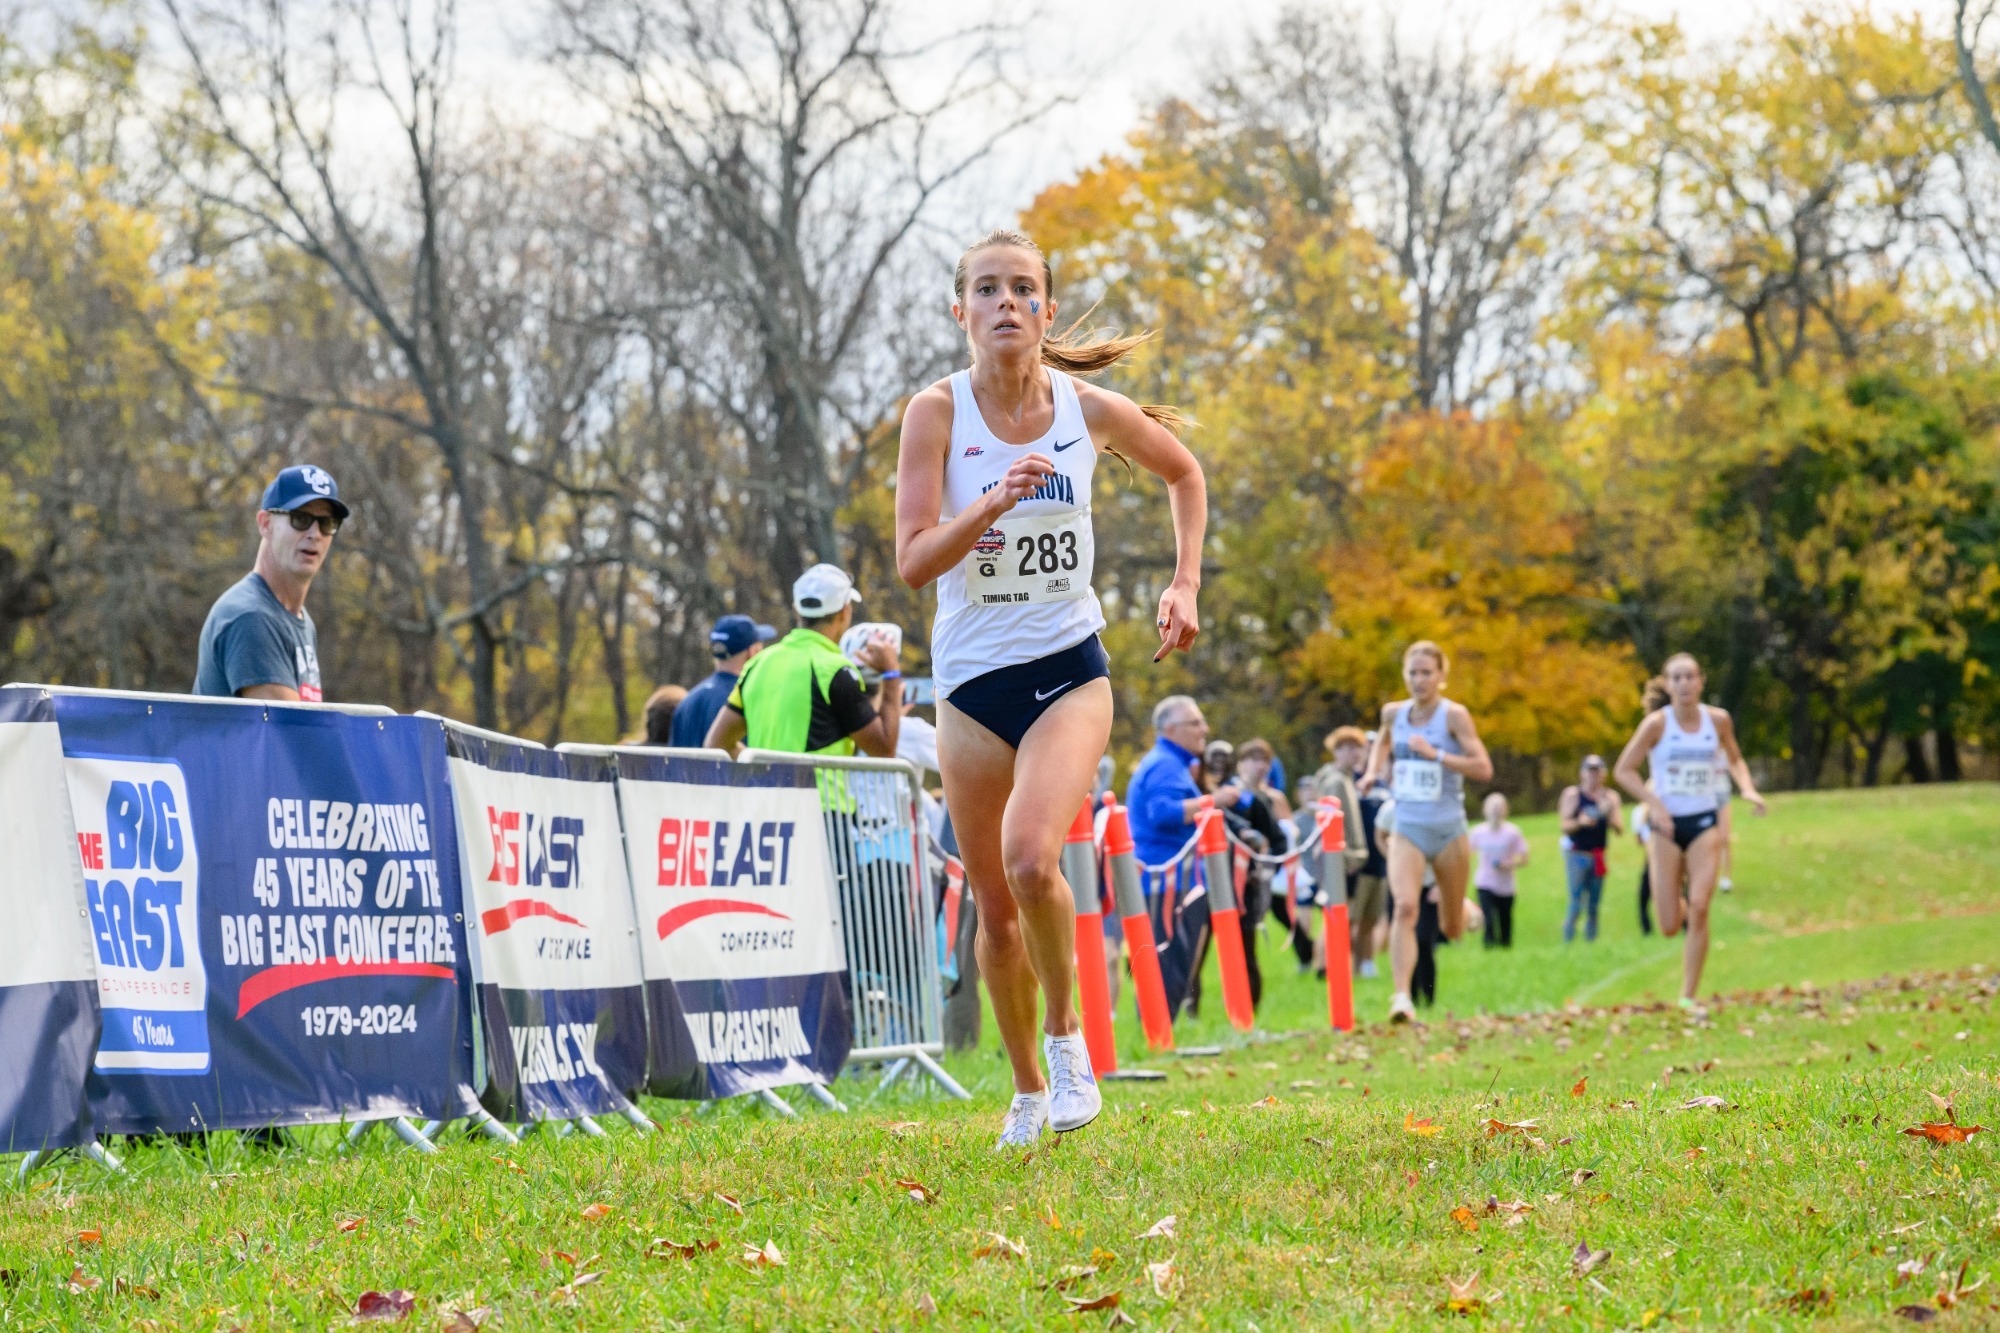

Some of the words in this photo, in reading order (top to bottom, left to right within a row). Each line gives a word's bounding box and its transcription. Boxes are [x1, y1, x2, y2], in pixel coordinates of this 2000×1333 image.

[979, 562, 996, 578] G
[1017, 530, 1079, 577] 283
[982, 594, 1012, 603] TIMING
[1013, 592, 1030, 602] TAG
[1413, 769, 1438, 788] 185
[106, 780, 184, 872] BIG
[267, 797, 430, 852] CELEBRATING
[657, 818, 710, 887] BIG
[710, 821, 796, 887] EAST
[253, 857, 280, 908] 45
[284, 856, 368, 909] YEARS
[375, 859, 414, 909] OF
[85, 876, 185, 972] EAST
[220, 914, 264, 965] BIG
[268, 914, 327, 965] EAST
[101, 978, 191, 996] CONFERENCE
[132, 1014, 145, 1045] 45
[144, 1016, 174, 1047] Years
[301, 1004, 418, 1036] 1979-2024
